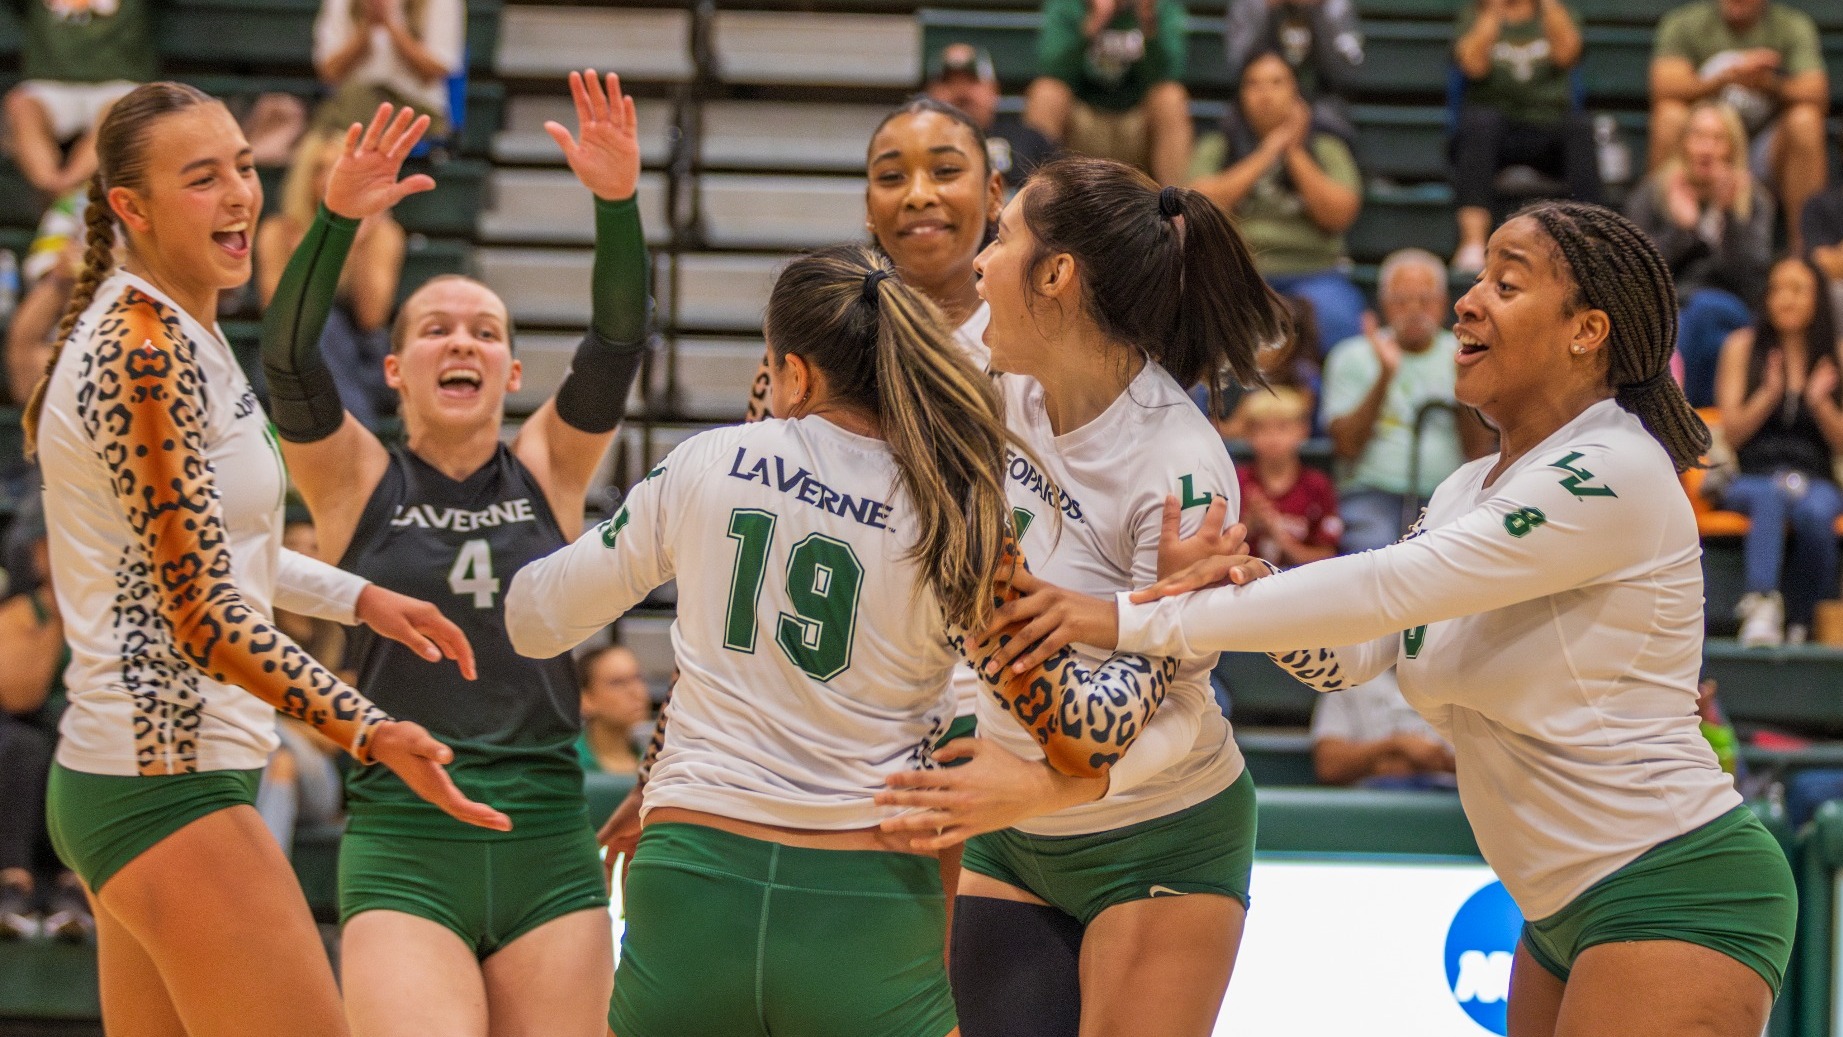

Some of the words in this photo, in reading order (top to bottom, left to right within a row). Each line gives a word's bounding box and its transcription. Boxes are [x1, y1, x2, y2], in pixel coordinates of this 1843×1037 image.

[1547, 450, 1619, 499] LV
[1503, 506, 1548, 538] 8
[448, 538, 500, 609] 4
[723, 508, 865, 683] 19
